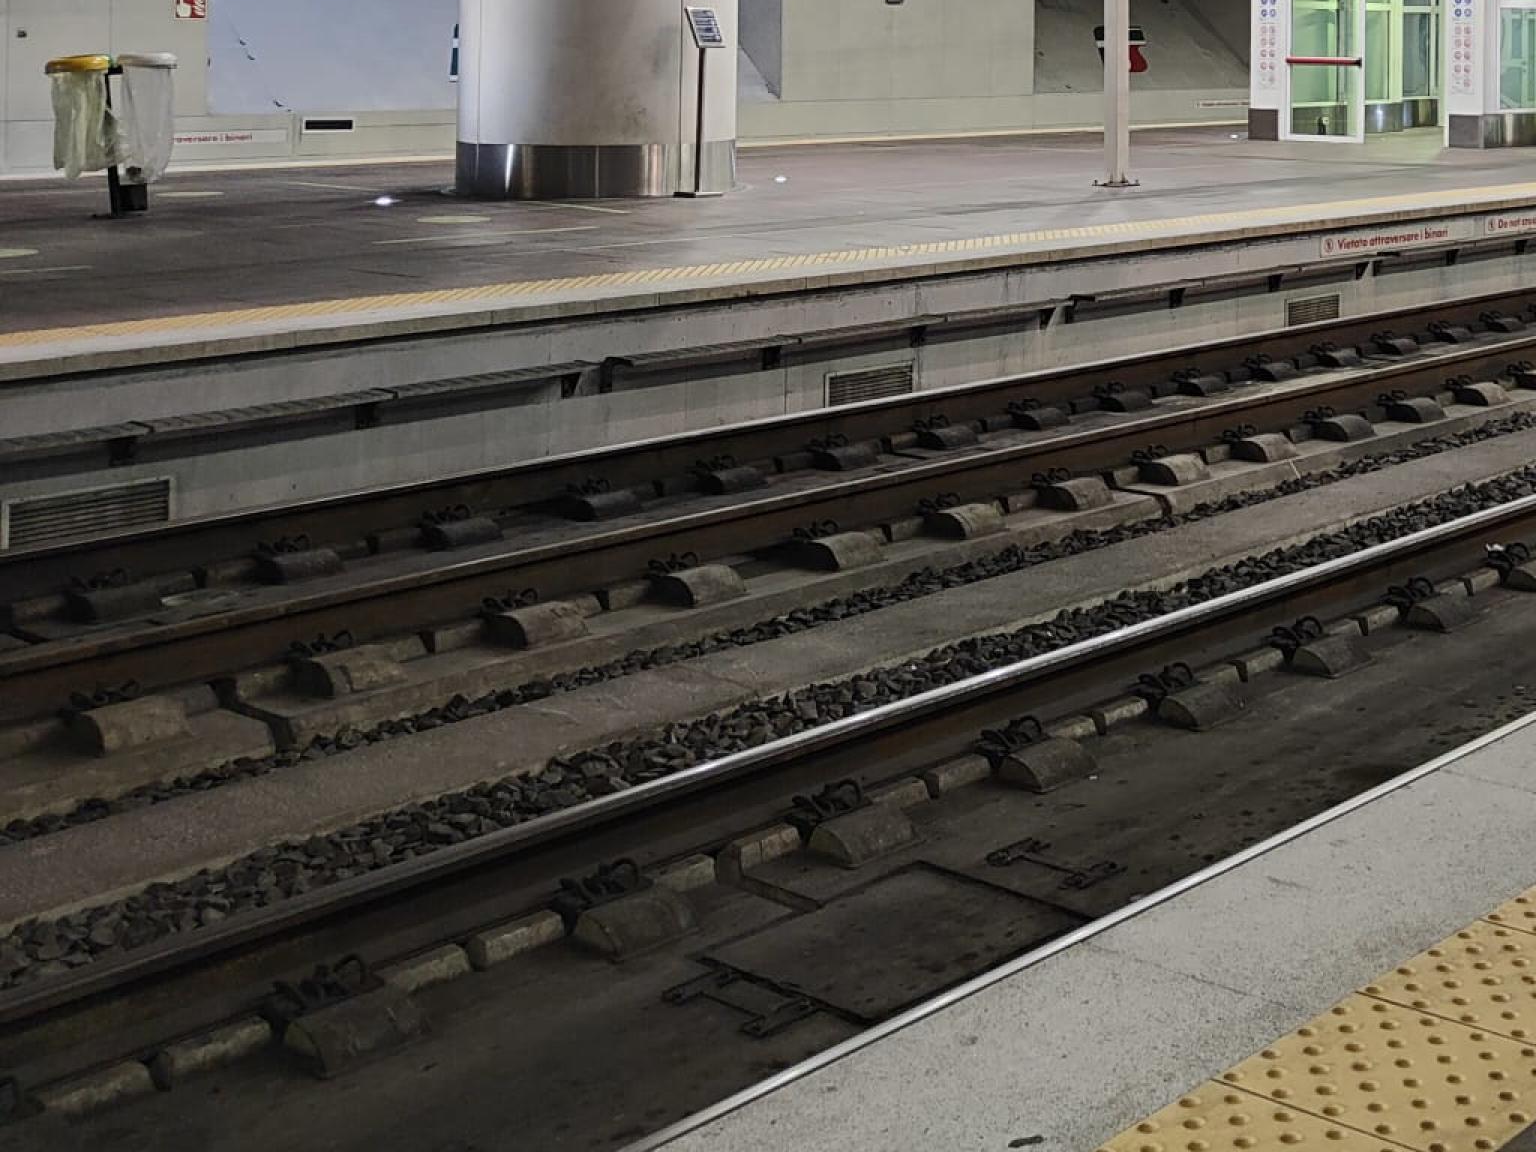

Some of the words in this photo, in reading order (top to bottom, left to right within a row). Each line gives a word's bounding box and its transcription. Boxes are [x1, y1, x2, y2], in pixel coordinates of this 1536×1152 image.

[1498, 219, 1508, 229] Do
[1509, 217, 1520, 228] not
[1337, 237, 1368, 250] Vietato
[1369, 232, 1420, 247] attraversare
[1424, 227, 1449, 240] binari
